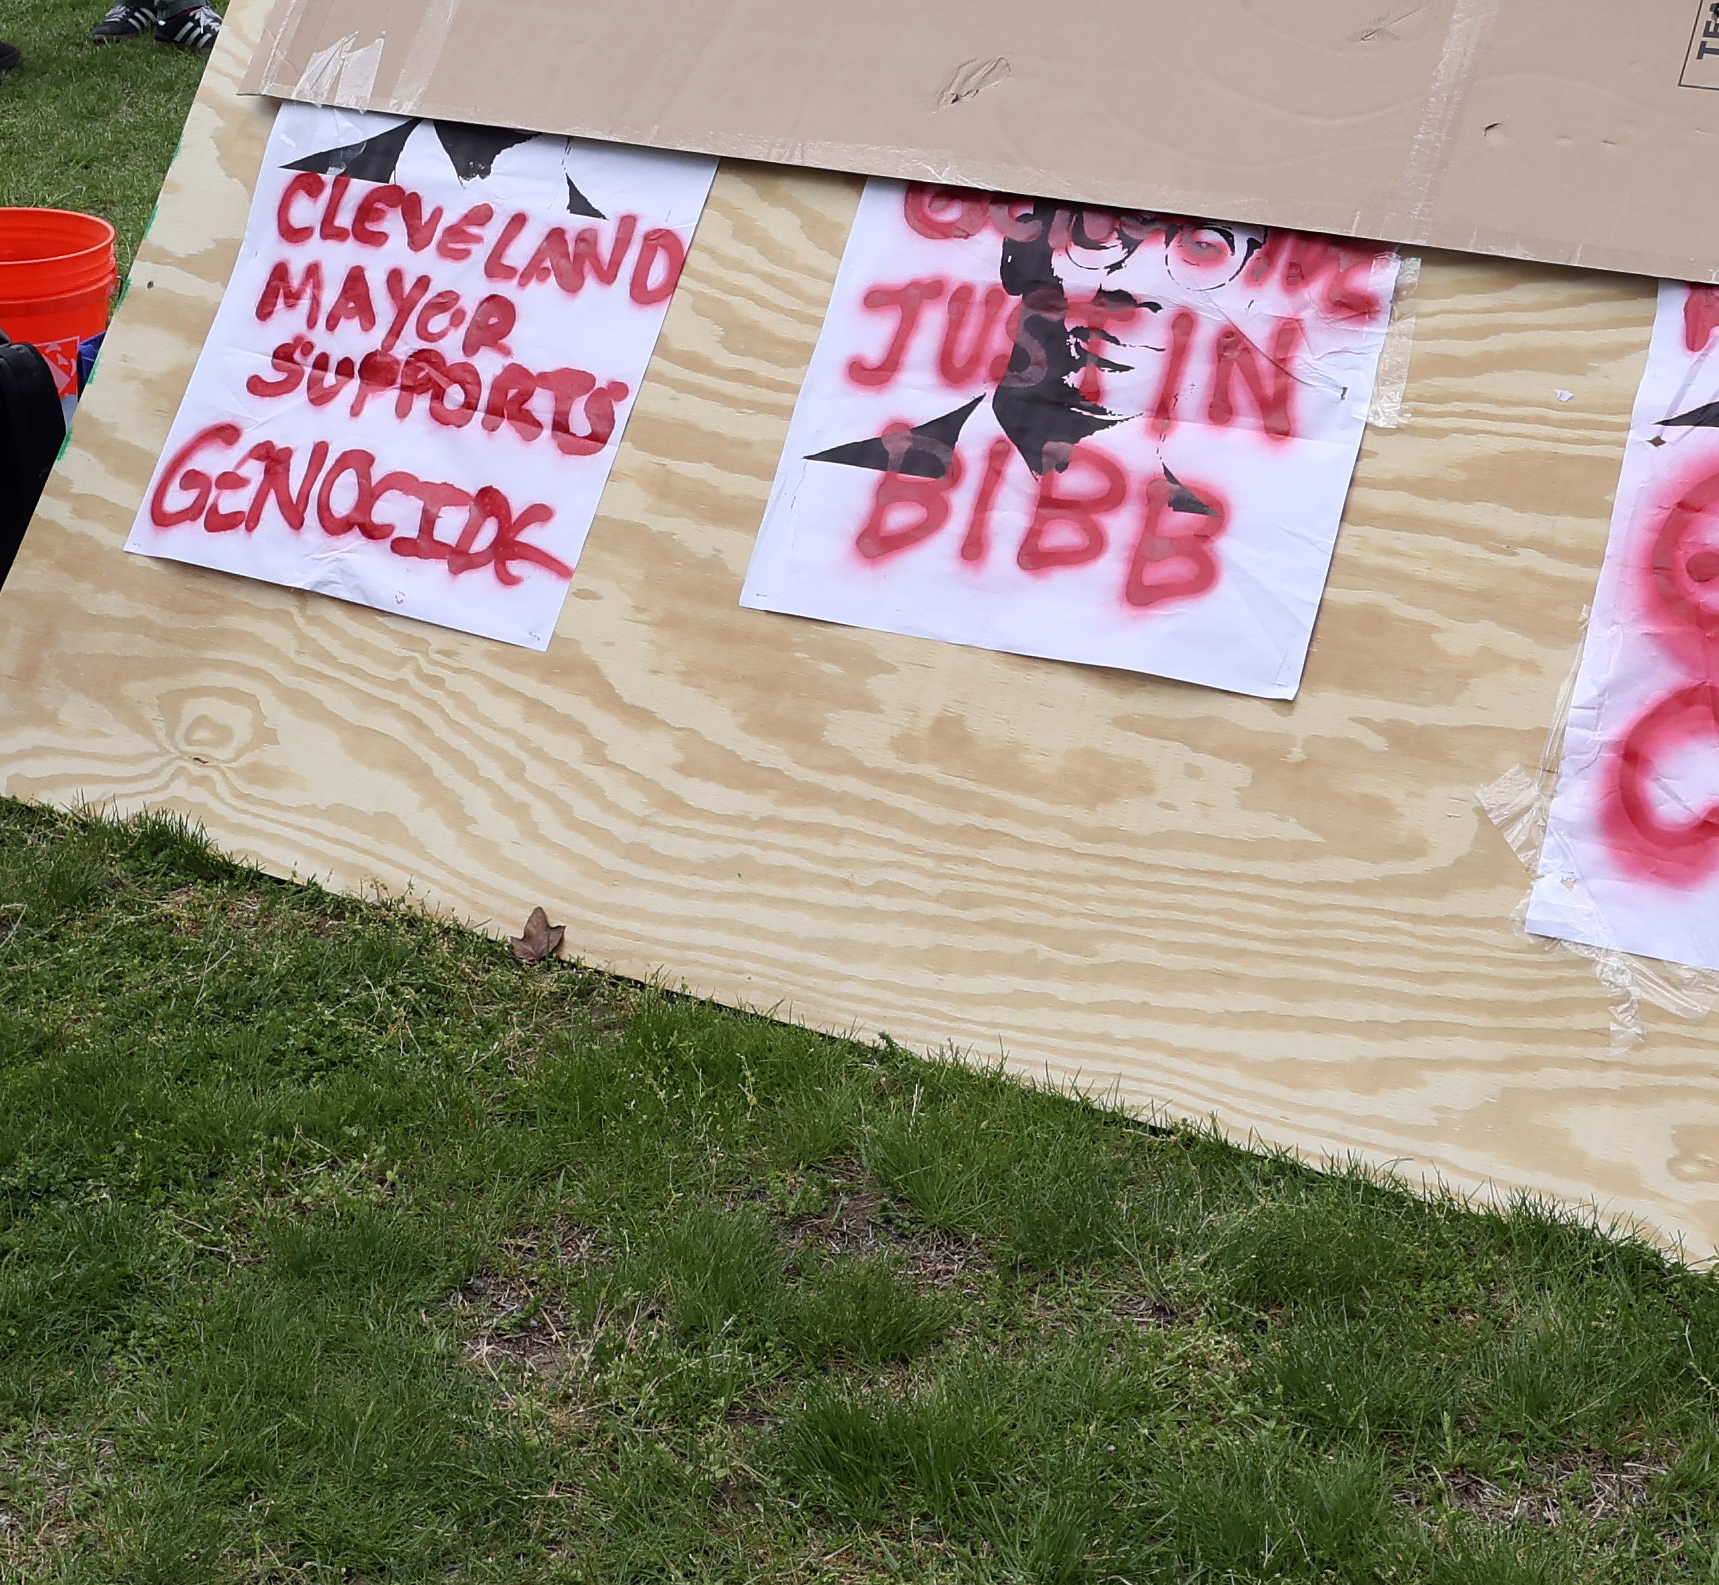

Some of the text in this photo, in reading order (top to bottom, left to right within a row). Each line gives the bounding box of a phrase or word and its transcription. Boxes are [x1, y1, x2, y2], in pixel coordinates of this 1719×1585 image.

[255, 260, 517, 358] MAYOR
[275, 171, 687, 306] CLEVELAND
[245, 334, 630, 458] SUPPORTS
[845, 278, 1307, 442] JUSTIN
[148, 422, 574, 586] GENOCIDE
[851, 421, 1232, 609] BIBB
